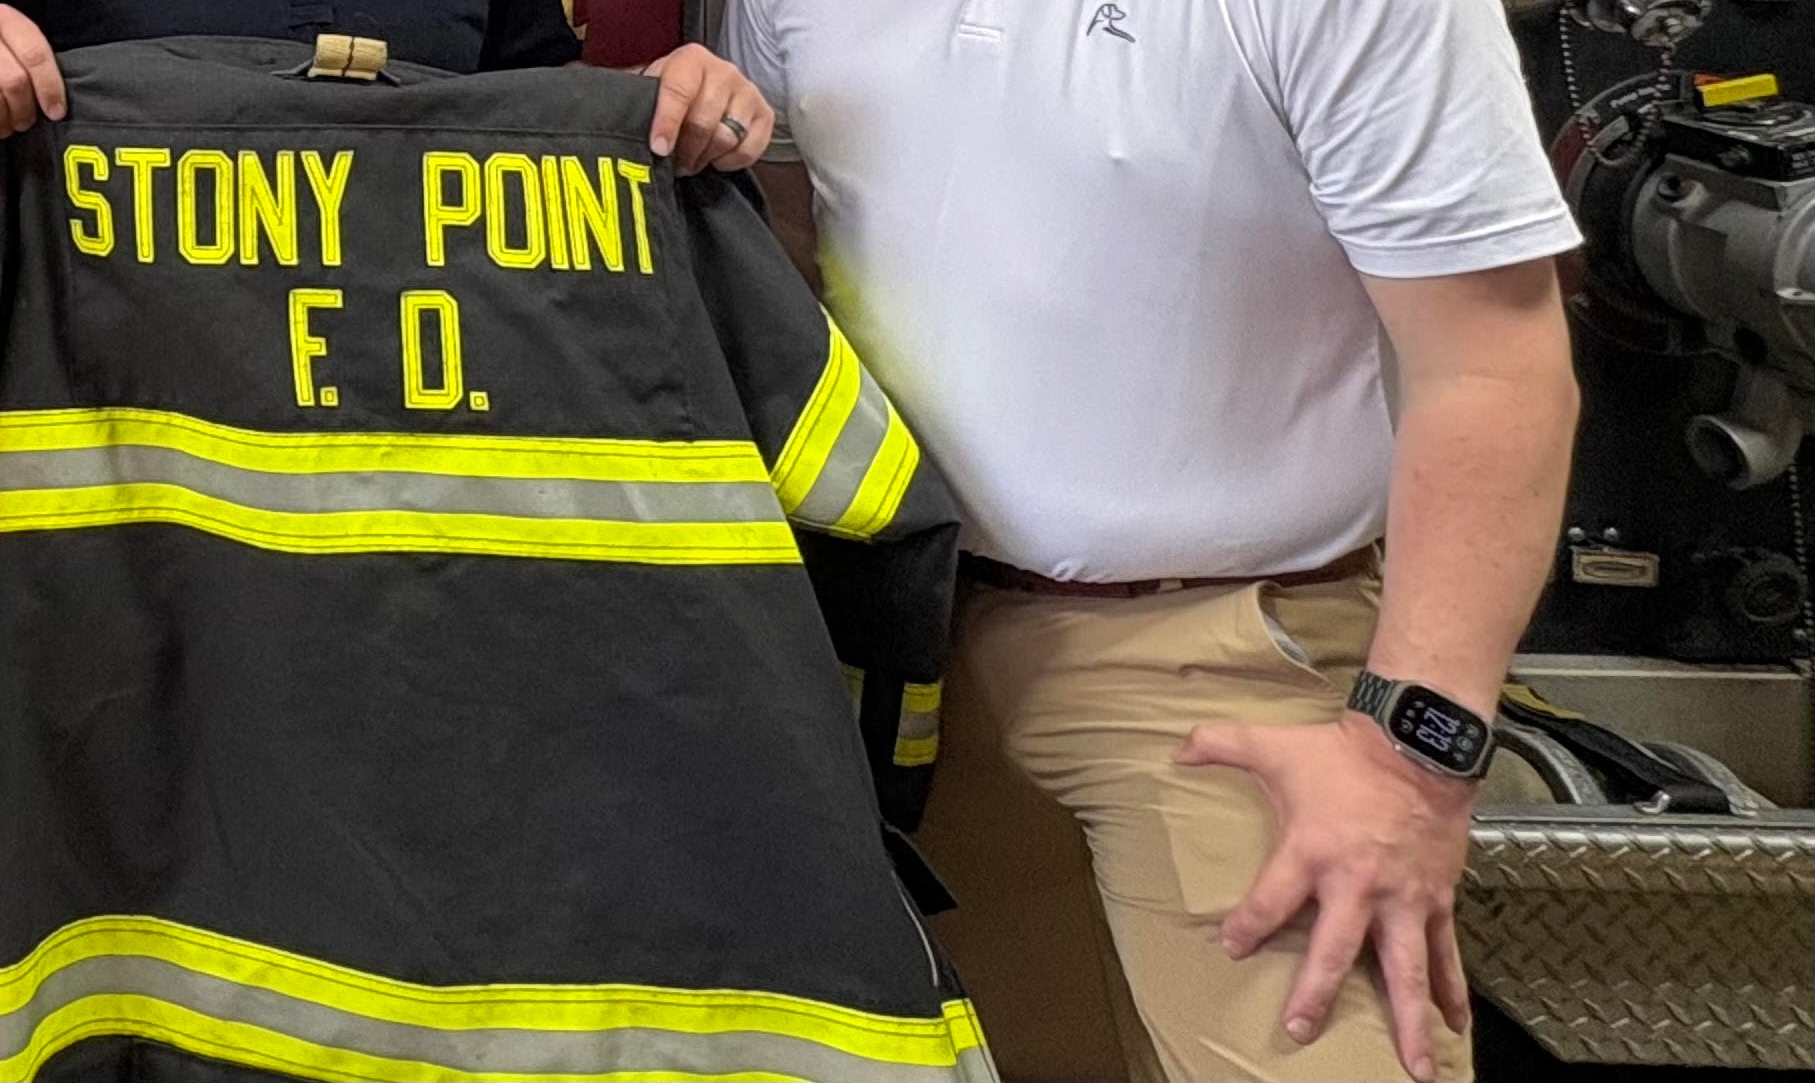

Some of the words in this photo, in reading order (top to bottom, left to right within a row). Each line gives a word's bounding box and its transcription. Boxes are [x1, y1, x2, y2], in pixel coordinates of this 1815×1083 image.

[63, 144, 354, 267] STONY
[423, 151, 654, 275] POINT
[288, 287, 344, 407] F.
[399, 288, 490, 413] D.
[1415, 706, 1461, 752] 12:13
